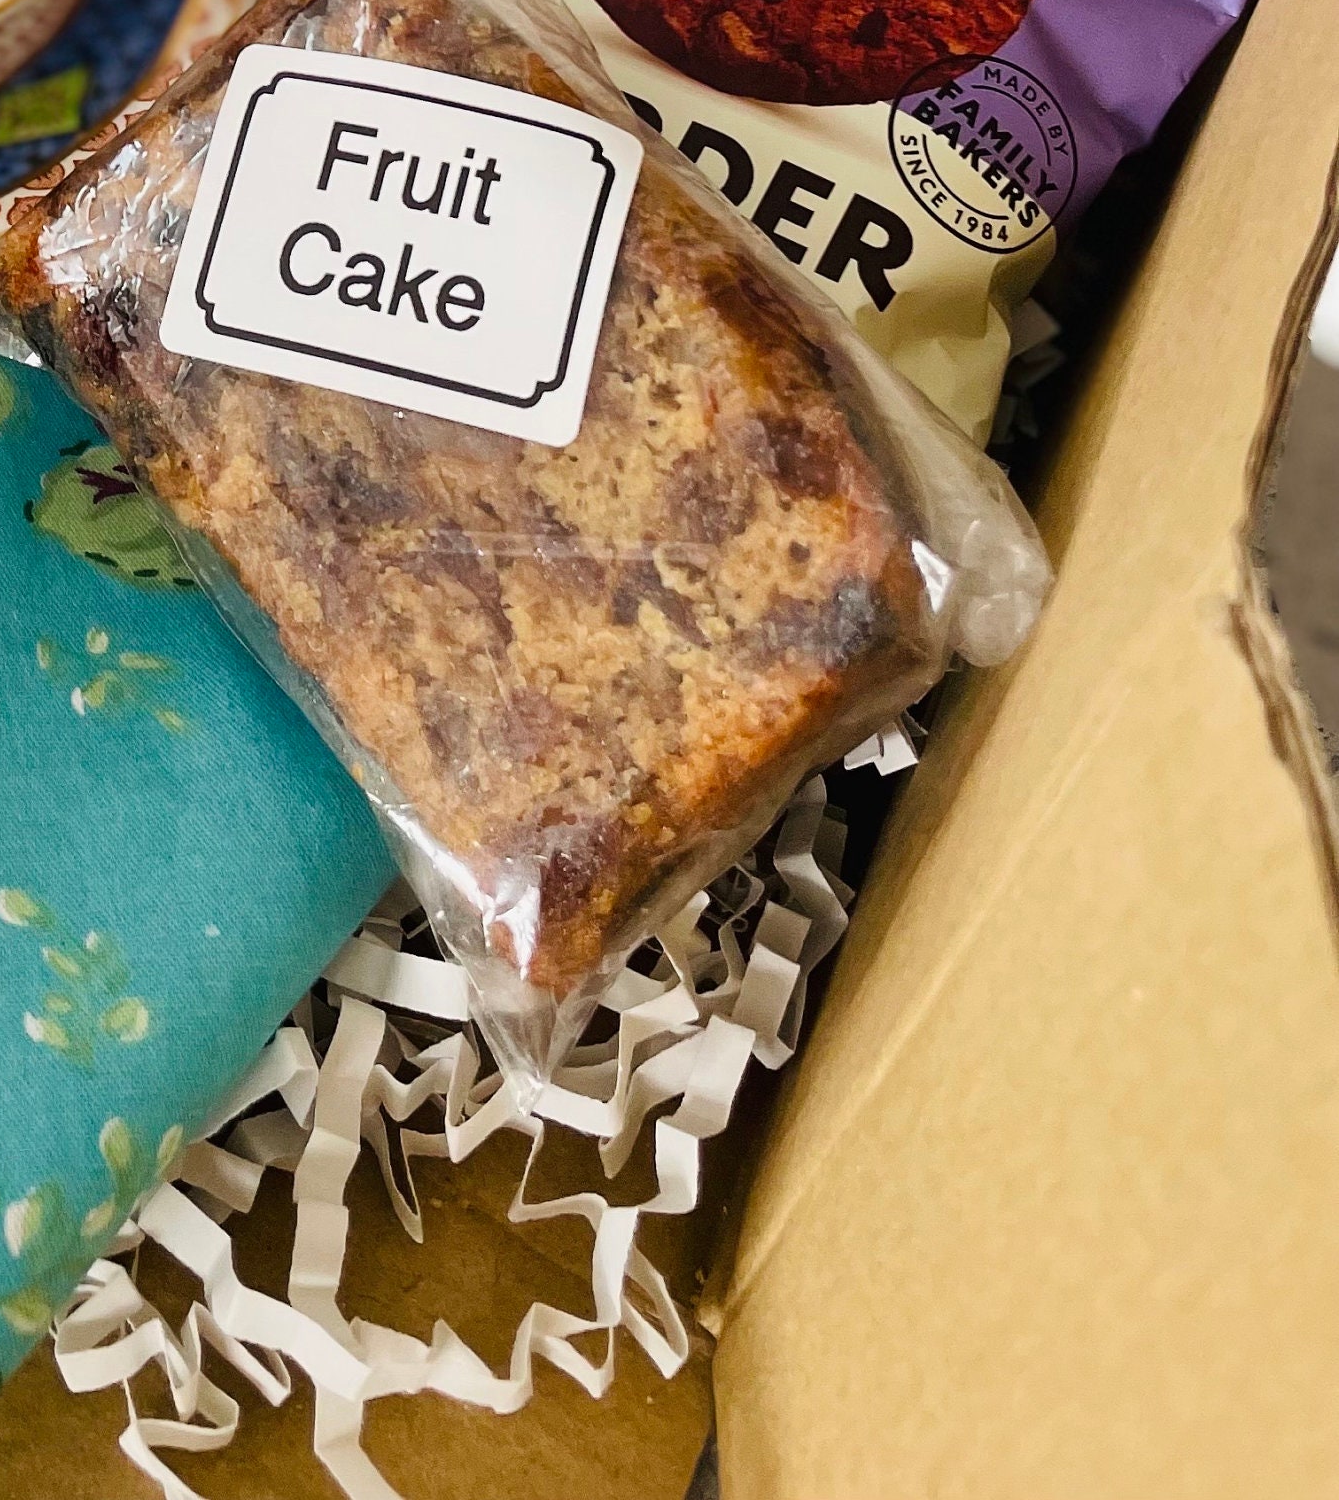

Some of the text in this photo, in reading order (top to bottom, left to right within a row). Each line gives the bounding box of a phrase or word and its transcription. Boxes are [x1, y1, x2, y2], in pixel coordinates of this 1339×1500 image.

[911, 97, 1040, 229] BAKERS
[935, 79, 1059, 198] FAMILY
[984, 65, 1069, 157] MADE BY
[316, 120, 502, 226] Fruit
[621, 90, 914, 312] DER
[900, 134, 1010, 243] SINCE 1984
[278, 222, 486, 332] Cake
